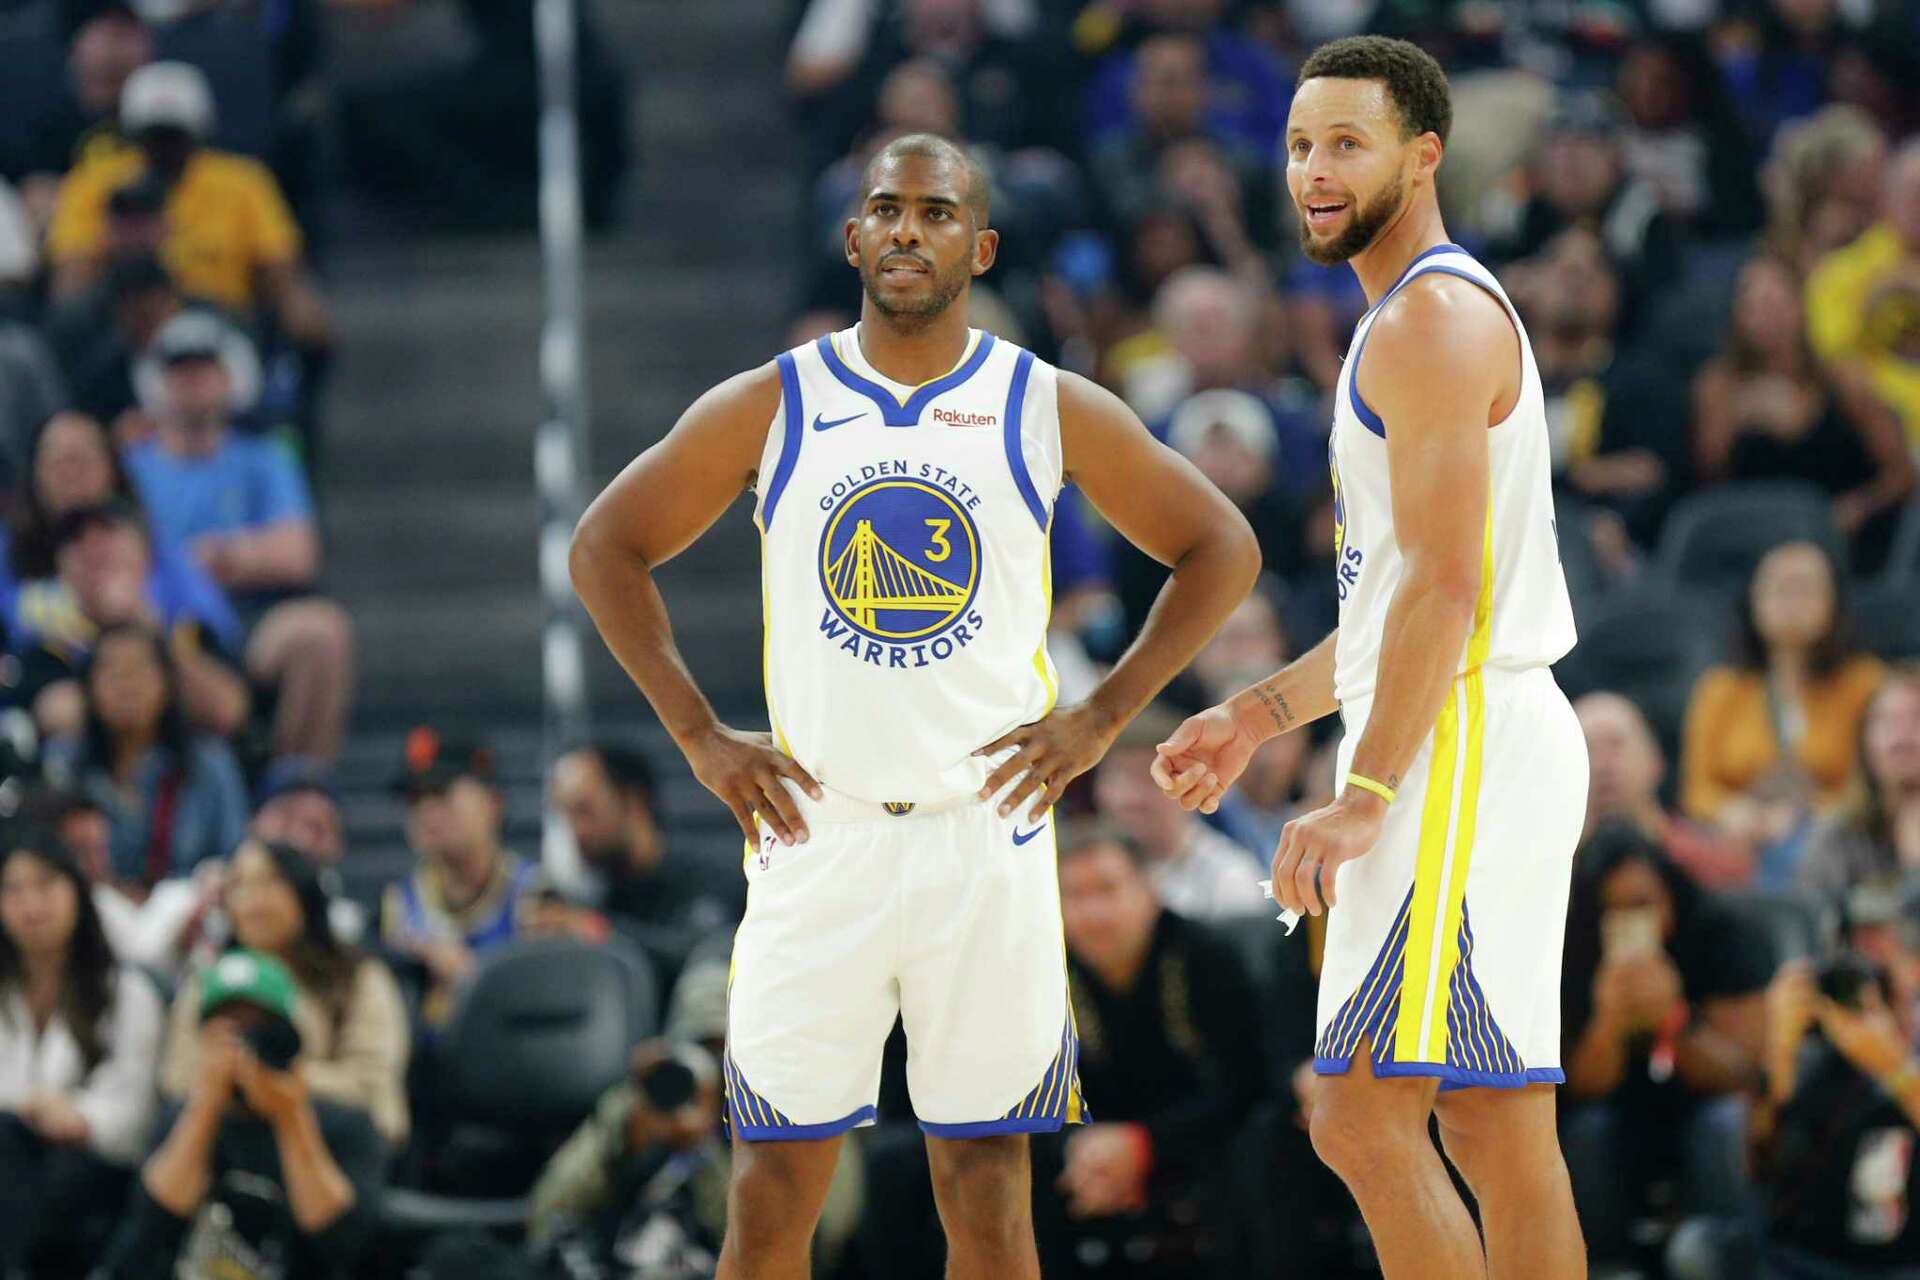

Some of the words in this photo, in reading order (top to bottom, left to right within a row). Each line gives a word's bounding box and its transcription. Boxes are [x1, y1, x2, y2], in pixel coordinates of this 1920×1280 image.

[933, 408, 997, 425] Rakuten
[819, 459, 908, 511] GOLDEN
[919, 463, 982, 511] STATE
[924, 518, 952, 563] 3
[818, 607, 984, 669] WARRIORS
